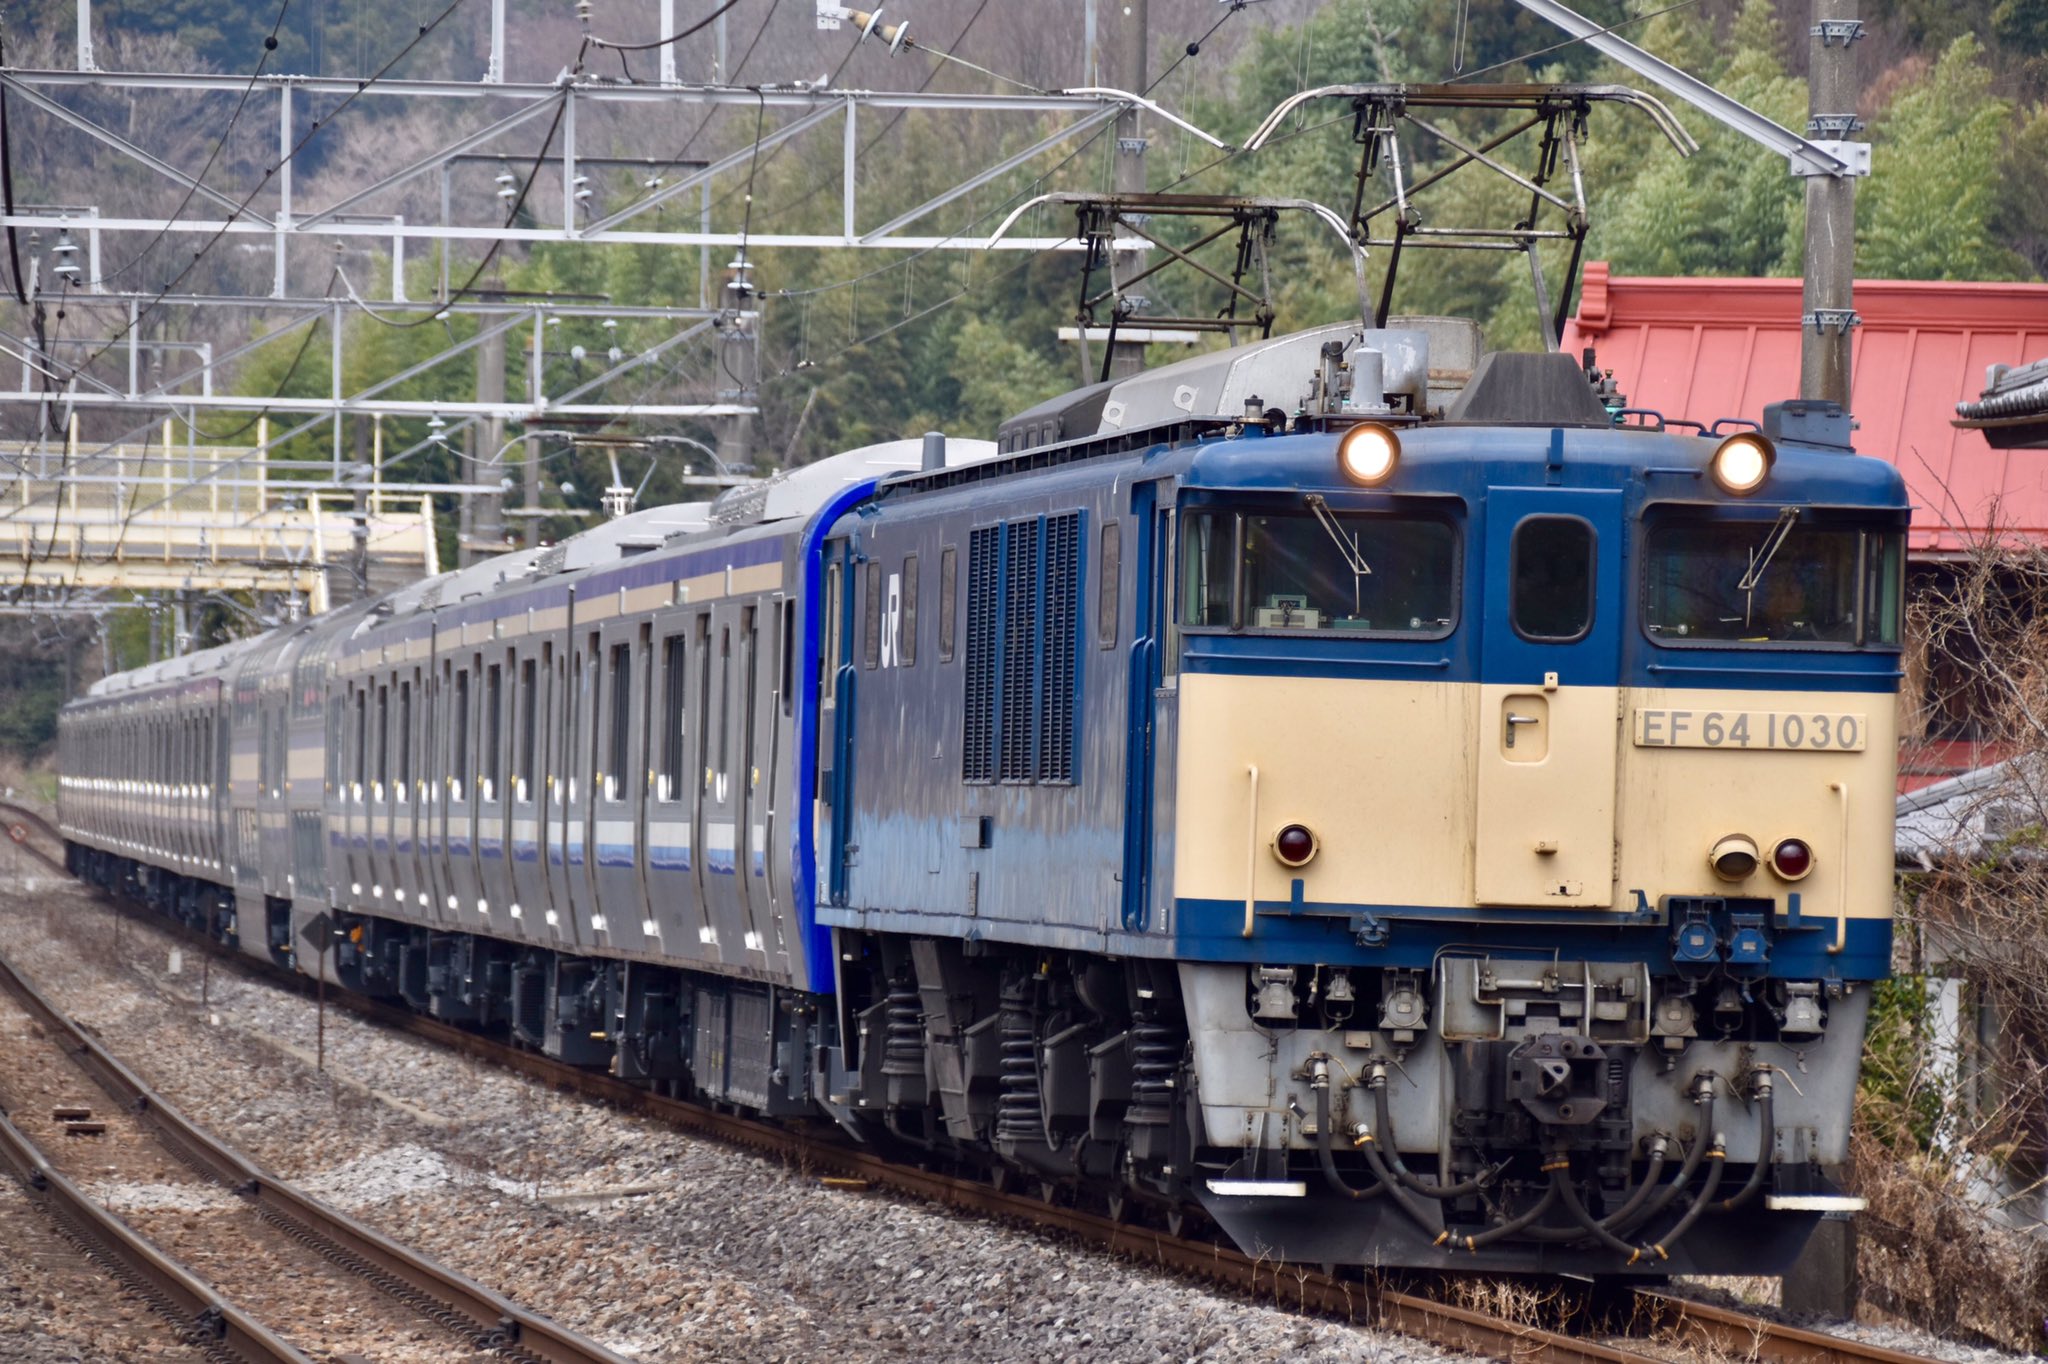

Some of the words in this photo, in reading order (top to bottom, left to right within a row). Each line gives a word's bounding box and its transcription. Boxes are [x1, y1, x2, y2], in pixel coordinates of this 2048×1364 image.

[881, 573, 900, 669] JR
[1643, 711, 1692, 746] EF
[1702, 712, 1751, 747] 64
[1767, 713, 1858, 749] 1030
